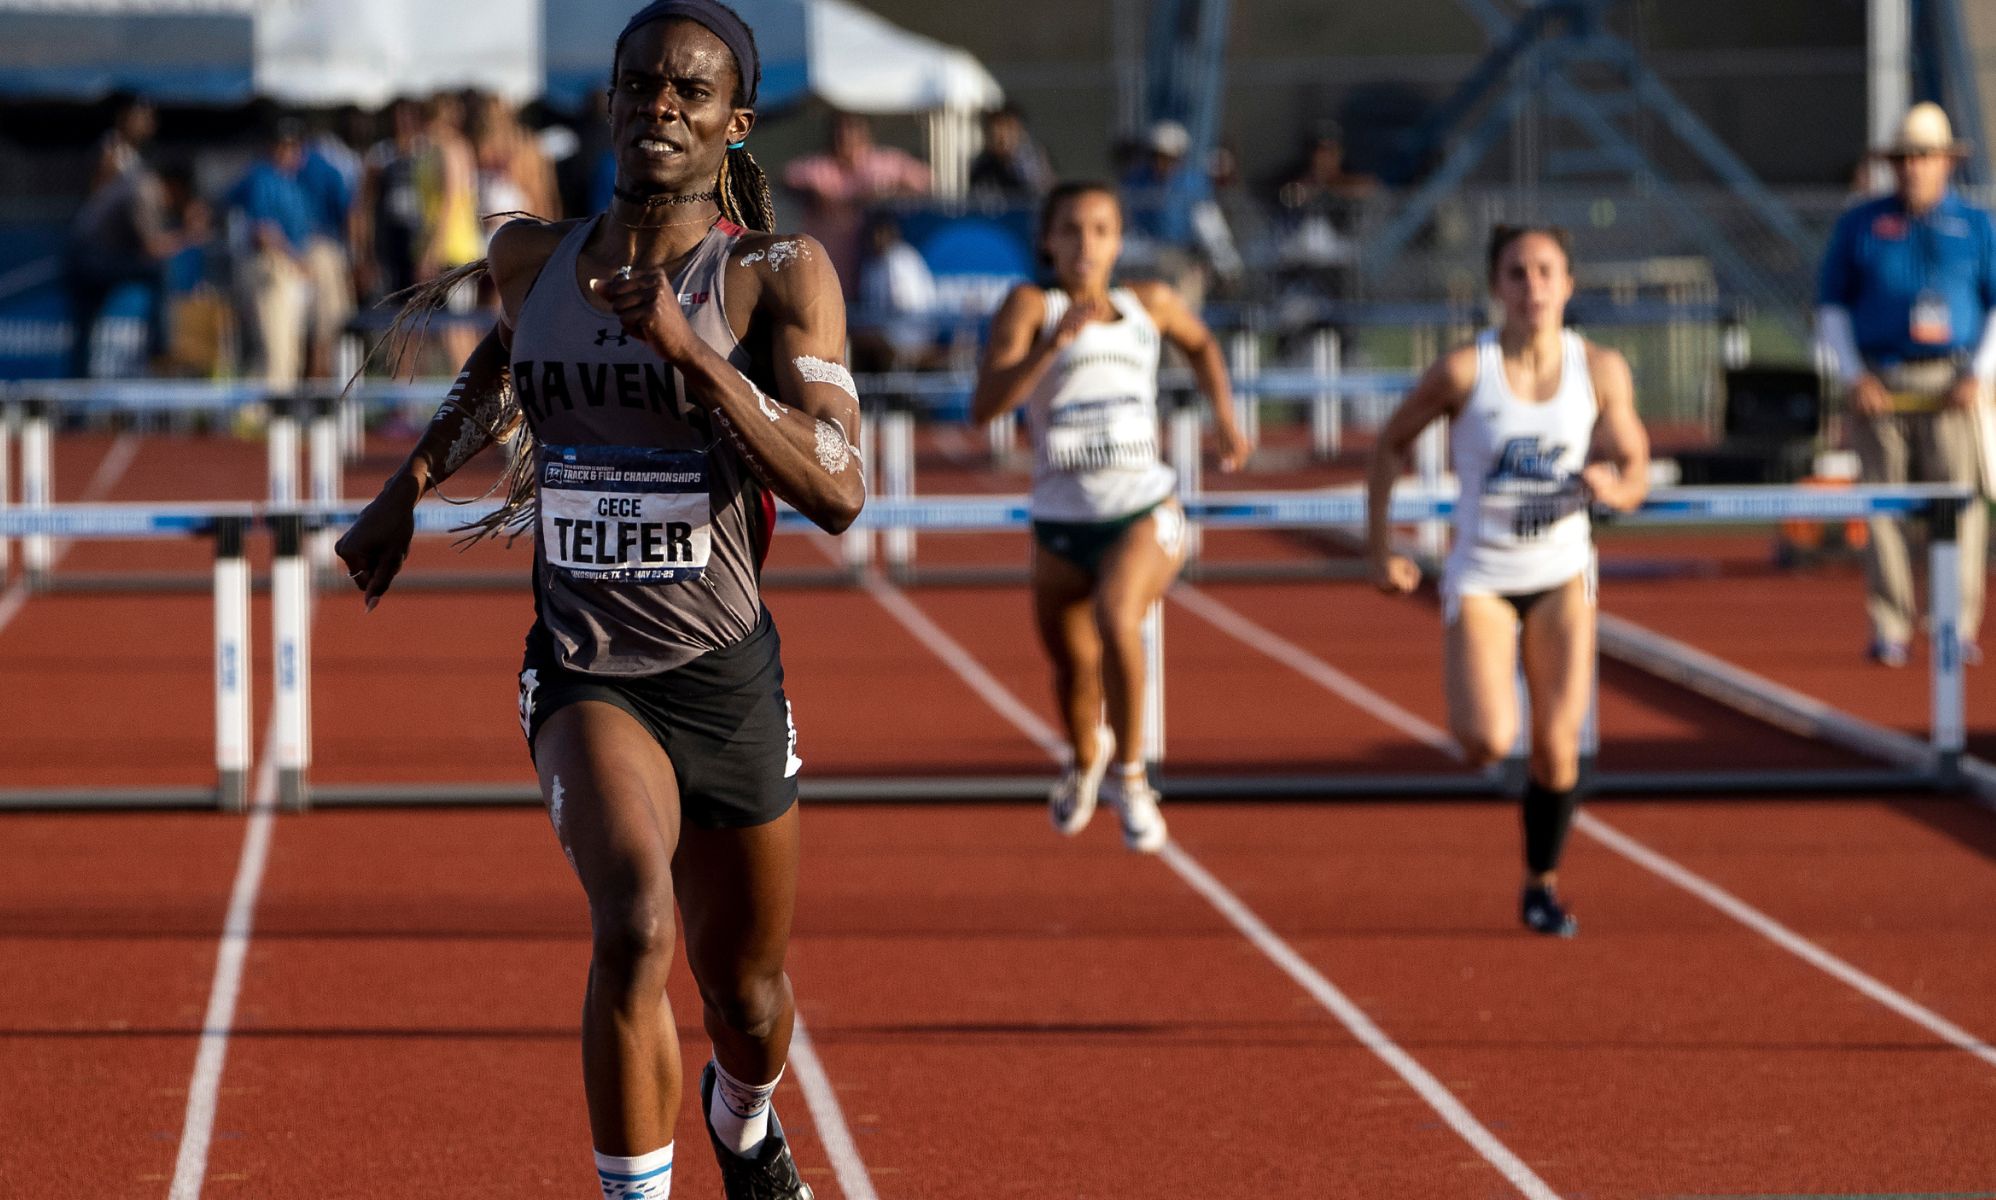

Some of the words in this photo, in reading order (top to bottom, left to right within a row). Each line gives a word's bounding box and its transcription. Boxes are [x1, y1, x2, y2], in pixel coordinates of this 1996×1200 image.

[563, 469, 590, 480] TRACK
[590, 471, 598, 481] &
[598, 471, 622, 482] FIELD
[623, 472, 701, 483] CHAMPIONSHIPS
[597, 497, 642, 517] CECE
[554, 517, 693, 564] TELFER
[611, 570, 620, 578] TX
